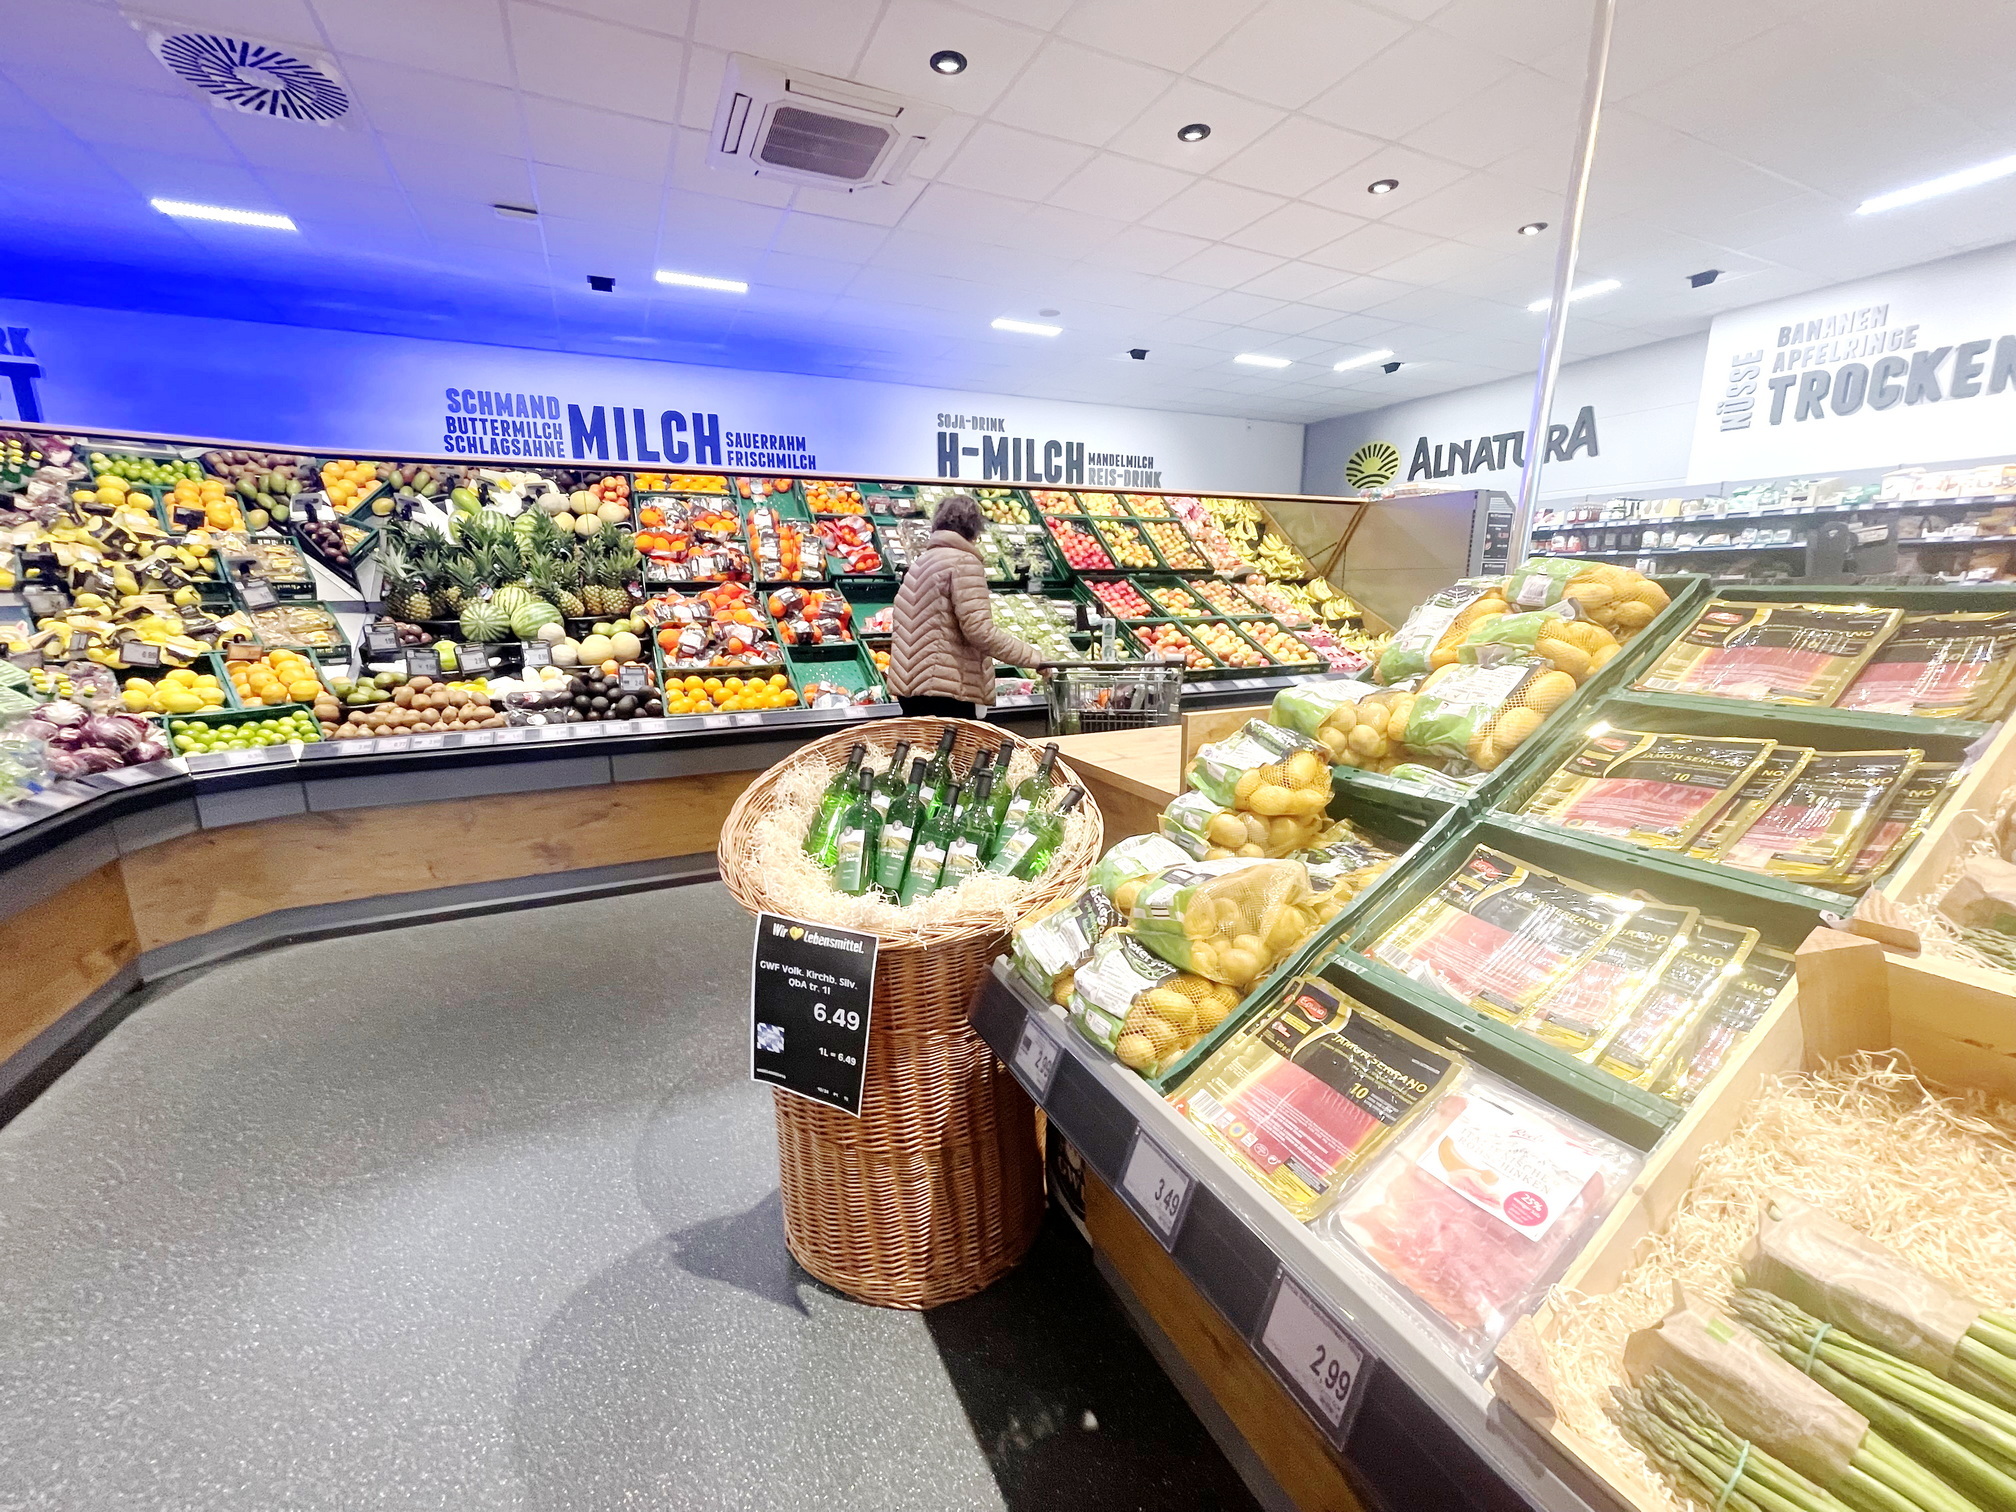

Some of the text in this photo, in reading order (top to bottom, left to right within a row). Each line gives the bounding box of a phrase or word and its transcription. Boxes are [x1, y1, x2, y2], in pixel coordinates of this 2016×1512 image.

[1777, 303, 1889, 348] BANANEN
[1772, 323, 1920, 373] APFELRINGE
[445, 387, 561, 420] SCHMAND
[1716, 349, 1764, 433] NÜSSE
[445, 415, 563, 441] BUTTERMILCH
[567, 403, 722, 466] MILCH
[937, 413, 1005, 432] SOJA-DRINK
[444, 434, 565, 459] SCHLAGSAHNE
[725, 431, 807, 452] SAUERRAHM
[726, 450, 817, 470] FRISCHMILCH
[937, 431, 1084, 485] H-MILCH
[1088, 452, 1154, 469] MANDELMILCH
[1088, 468, 1162, 488] REIS-DRINK
[1672, 772, 1691, 782] 10
[772, 923, 865, 954] Wir Lebensmittel.
[759, 960, 858, 990] GWF Volk. Kirchb. Silv.
[788, 978, 807, 991] QbA
[809, 983, 821, 993] tr.
[813, 1002, 861, 1031] 6.49
[819, 1047, 829, 1058] 1L
[838, 1053, 857, 1066] 6.49
[1350, 1081, 1370, 1100] 10
[1521, 1192, 1544, 1213] 25%
[1309, 1344, 1350, 1401] 2.99
